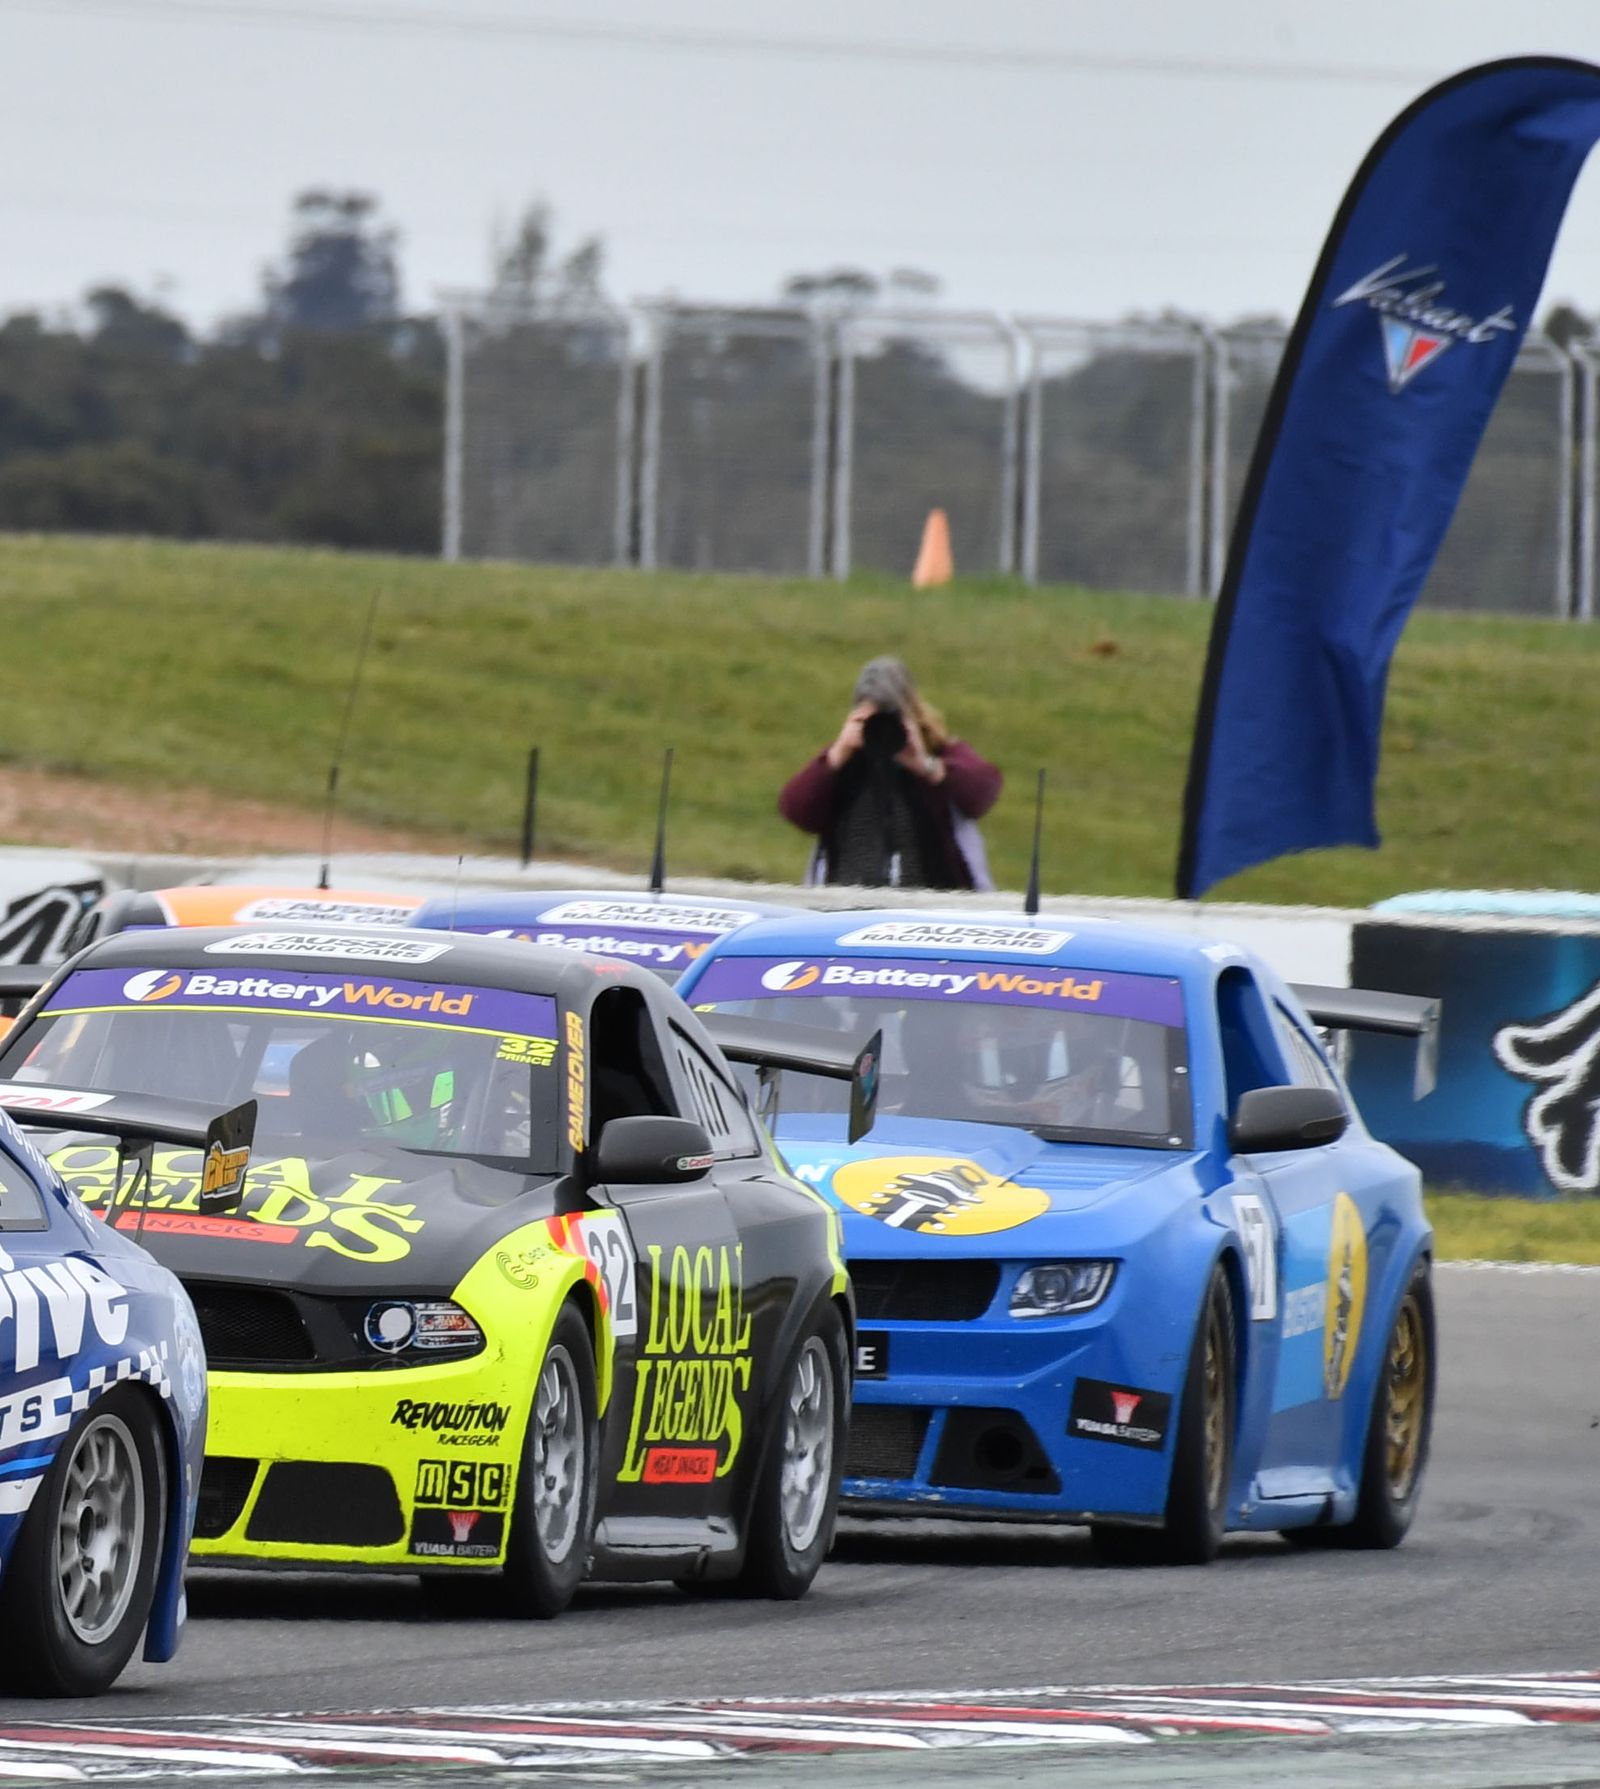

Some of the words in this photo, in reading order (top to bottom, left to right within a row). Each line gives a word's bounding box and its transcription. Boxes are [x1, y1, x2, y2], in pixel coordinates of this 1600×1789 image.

[1333, 253, 1517, 343] Valiant
[601, 904, 742, 921] AUSSIE
[861, 934, 964, 945] RACING
[972, 938, 1043, 949] CARS
[903, 924, 1051, 941] AUSSIE
[230, 942, 337, 952] RACING
[345, 947, 420, 959] CARS
[275, 935, 429, 953] AUSSIE
[500, 1037, 556, 1058] 32
[496, 1051, 552, 1066] PRINCE
[47, 1146, 417, 1216] OCAL
[589, 1228, 633, 1321] 32
[645, 1243, 751, 1355] LOCAL
[390, 1400, 512, 1432] REVOLUTION
[617, 1355, 752, 1482] LEGENDS
[437, 1433, 500, 1447] RACEGEAR
[414, 1541, 455, 1555] YUASA
